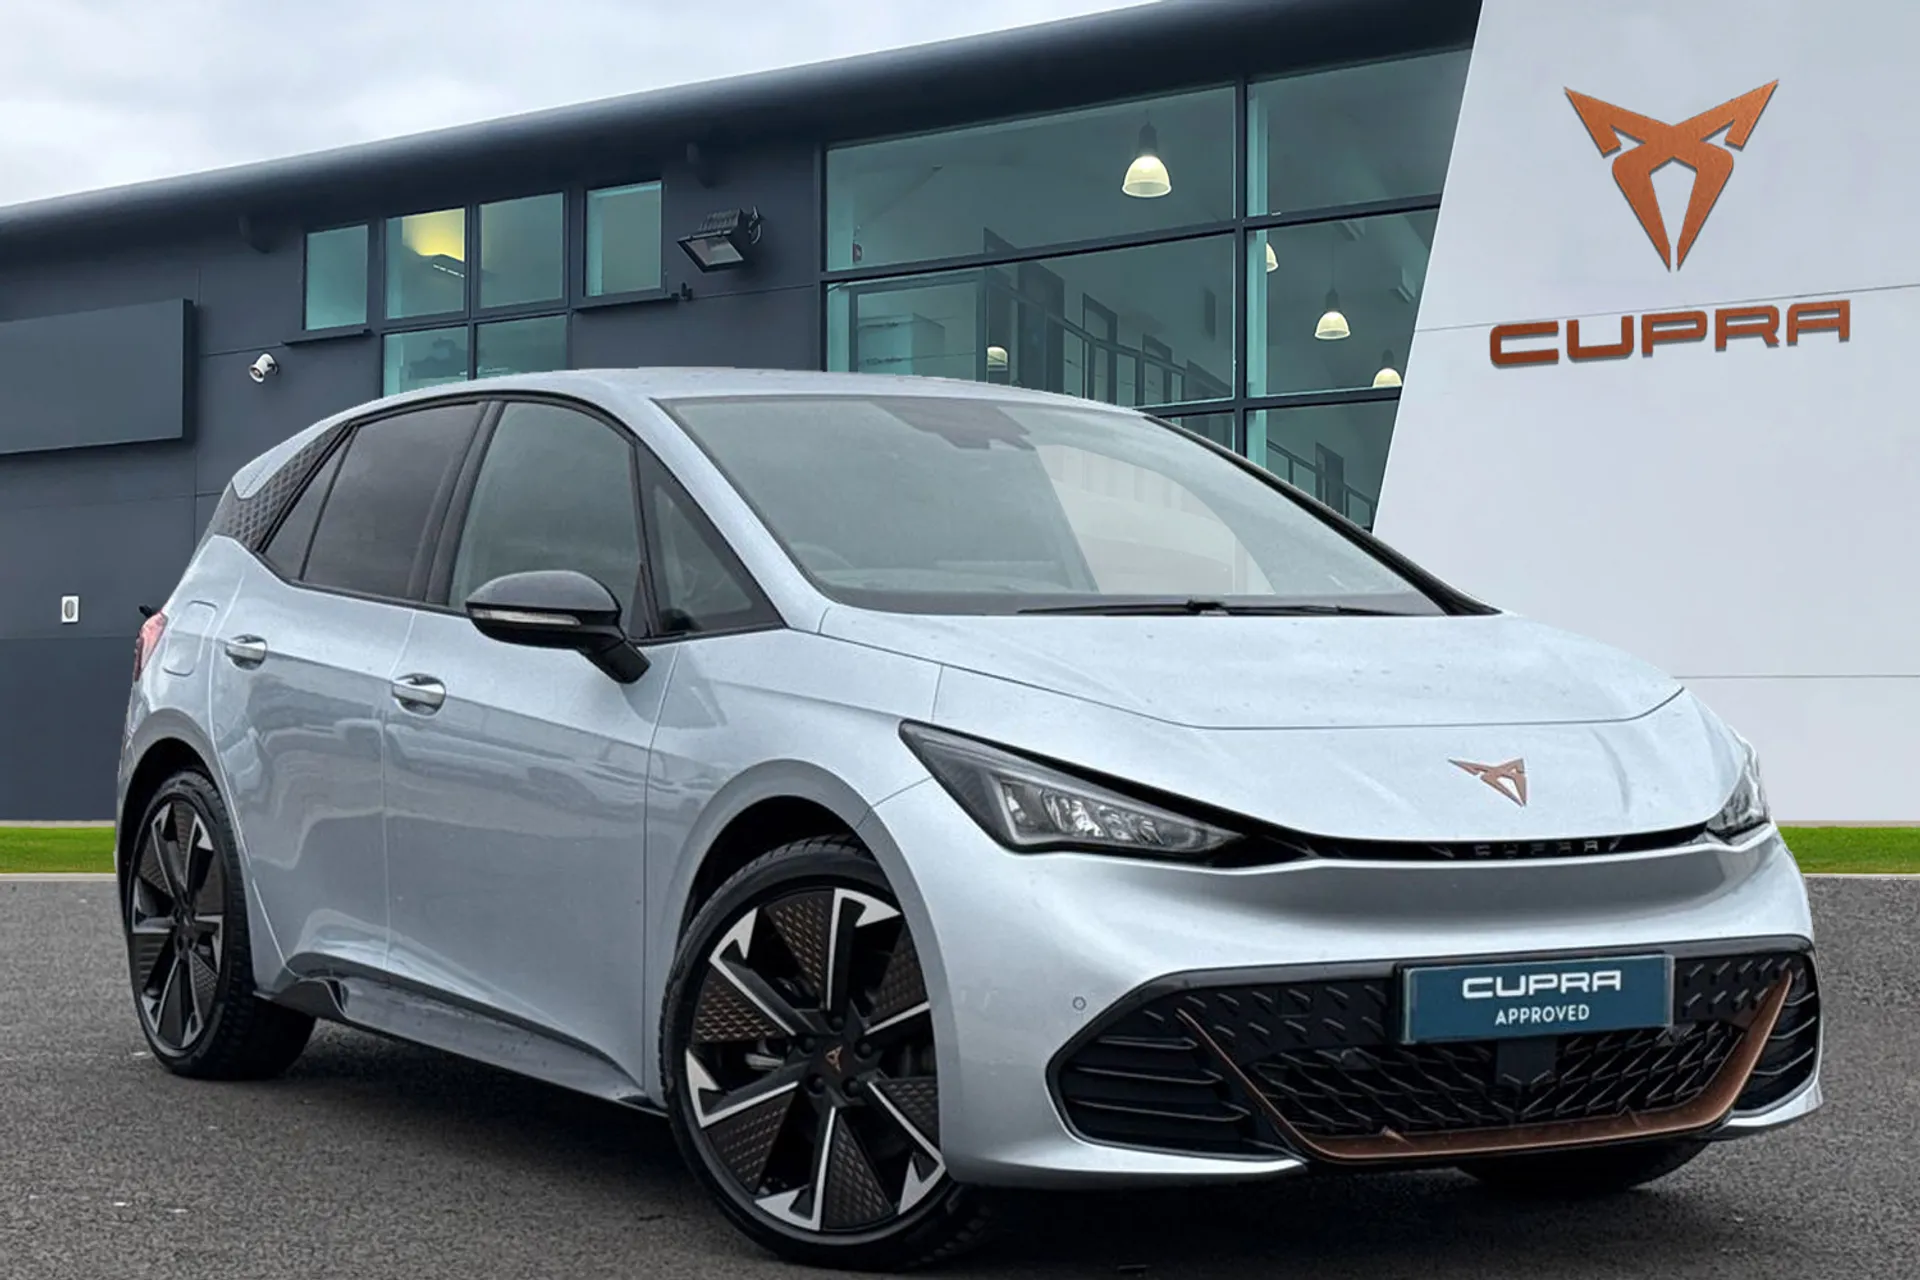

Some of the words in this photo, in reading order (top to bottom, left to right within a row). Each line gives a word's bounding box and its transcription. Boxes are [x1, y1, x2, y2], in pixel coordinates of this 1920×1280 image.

[1490, 299, 1850, 367] CUPRA
[1462, 970, 1622, 1000] CUPRA
[1495, 1004, 1590, 1026] APPROVED
